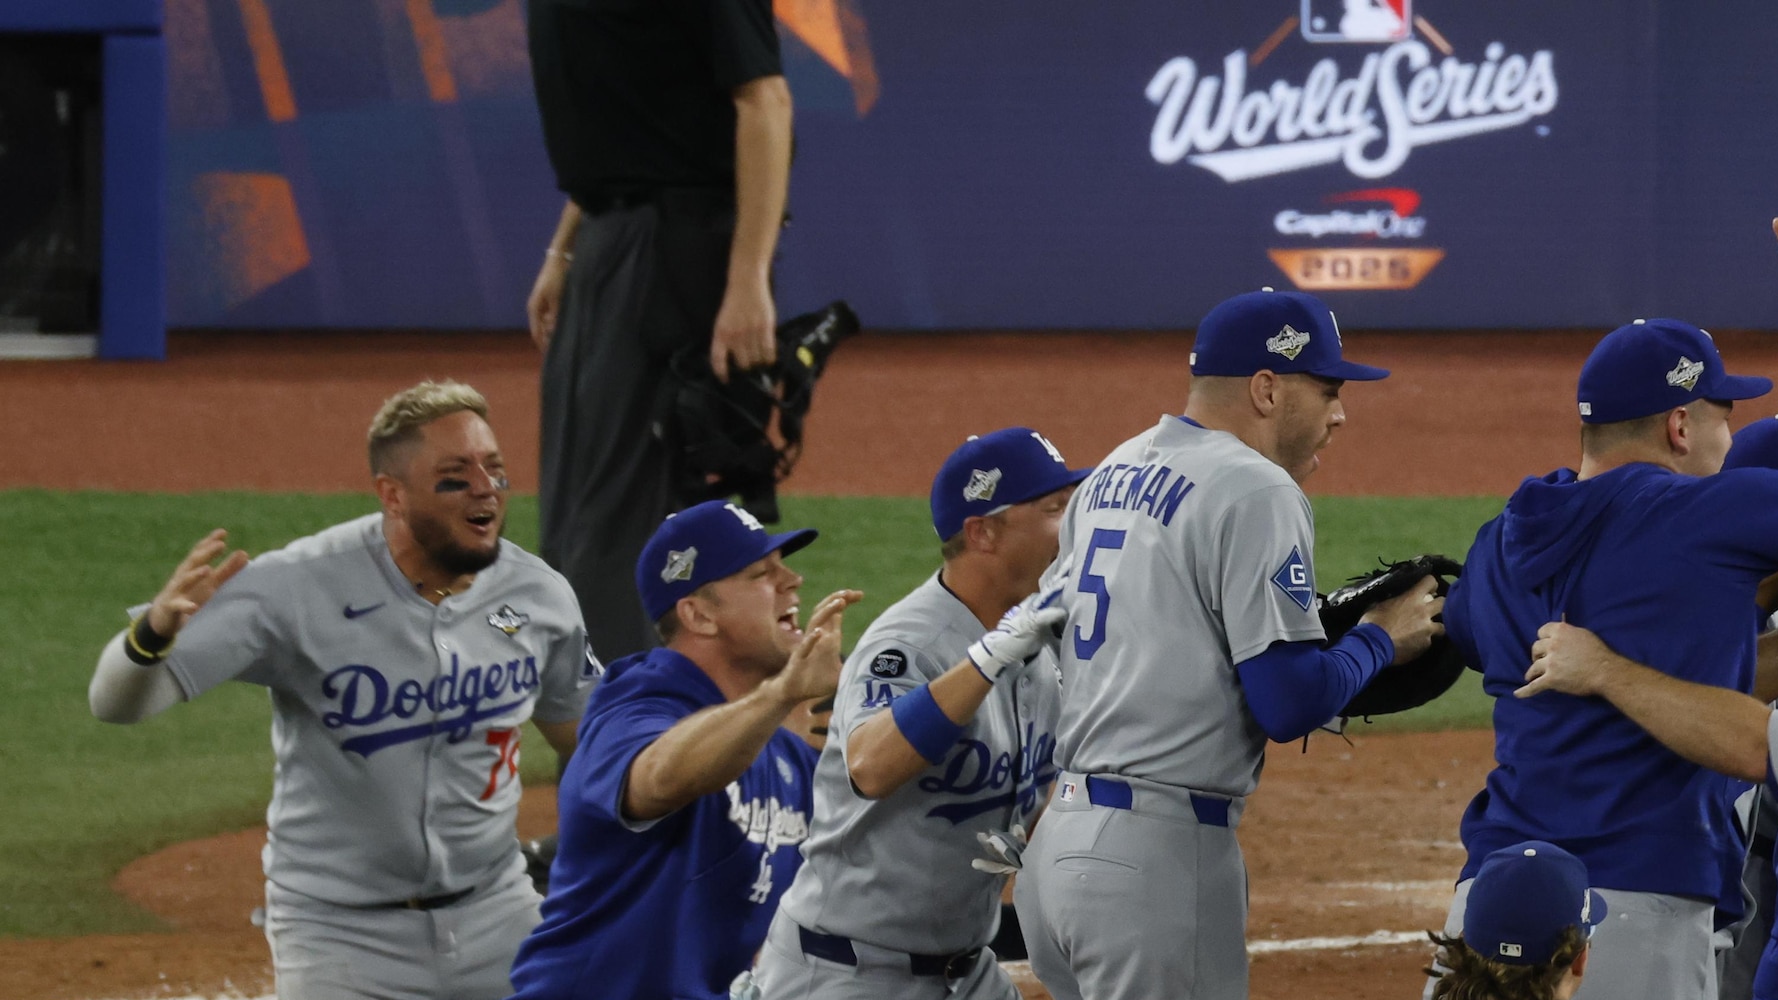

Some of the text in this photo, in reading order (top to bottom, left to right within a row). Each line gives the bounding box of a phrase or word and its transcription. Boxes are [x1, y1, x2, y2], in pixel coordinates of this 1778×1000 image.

[1145, 39, 1558, 179] World Series
[1274, 209, 1377, 238] Capital
[1302, 256, 1411, 280] 2025
[1084, 463, 1196, 528] FREEMAN
[1074, 527, 1127, 661] 5
[1290, 564, 1306, 585] G
[322, 652, 541, 745] Dodgers
[874, 658, 900, 676] 34
[919, 721, 1058, 816] Dodg
